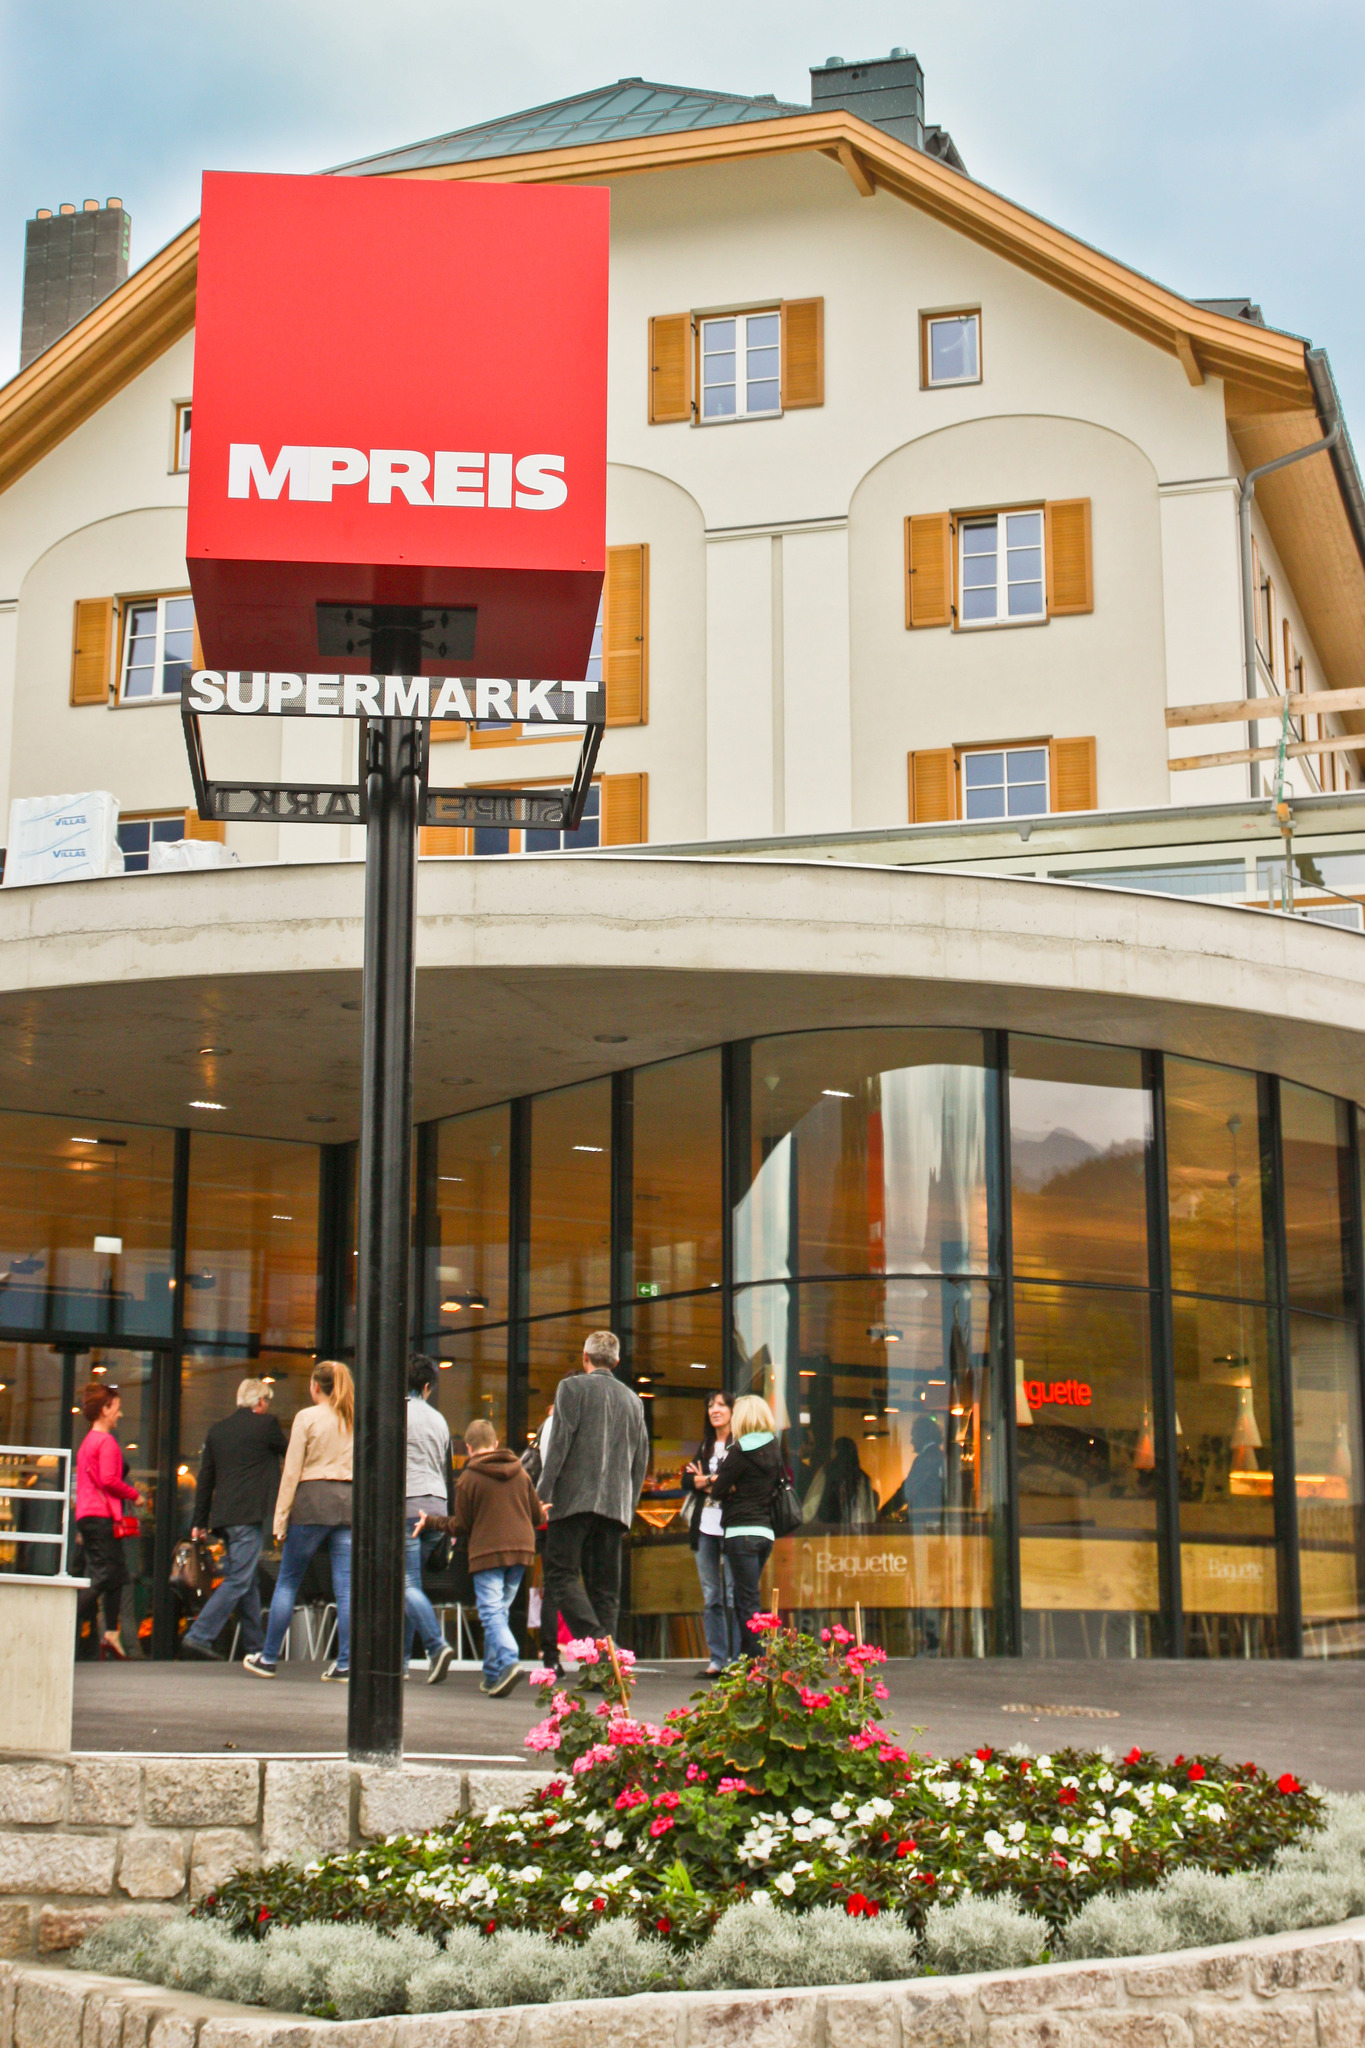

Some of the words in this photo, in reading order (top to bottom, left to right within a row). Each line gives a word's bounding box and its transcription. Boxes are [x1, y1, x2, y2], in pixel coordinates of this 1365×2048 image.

[227, 443, 568, 510] MPREIS
[188, 670, 599, 721] SUPERMARKT
[53, 848, 86, 858] VILLAS
[816, 1552, 908, 1577] Baguette
